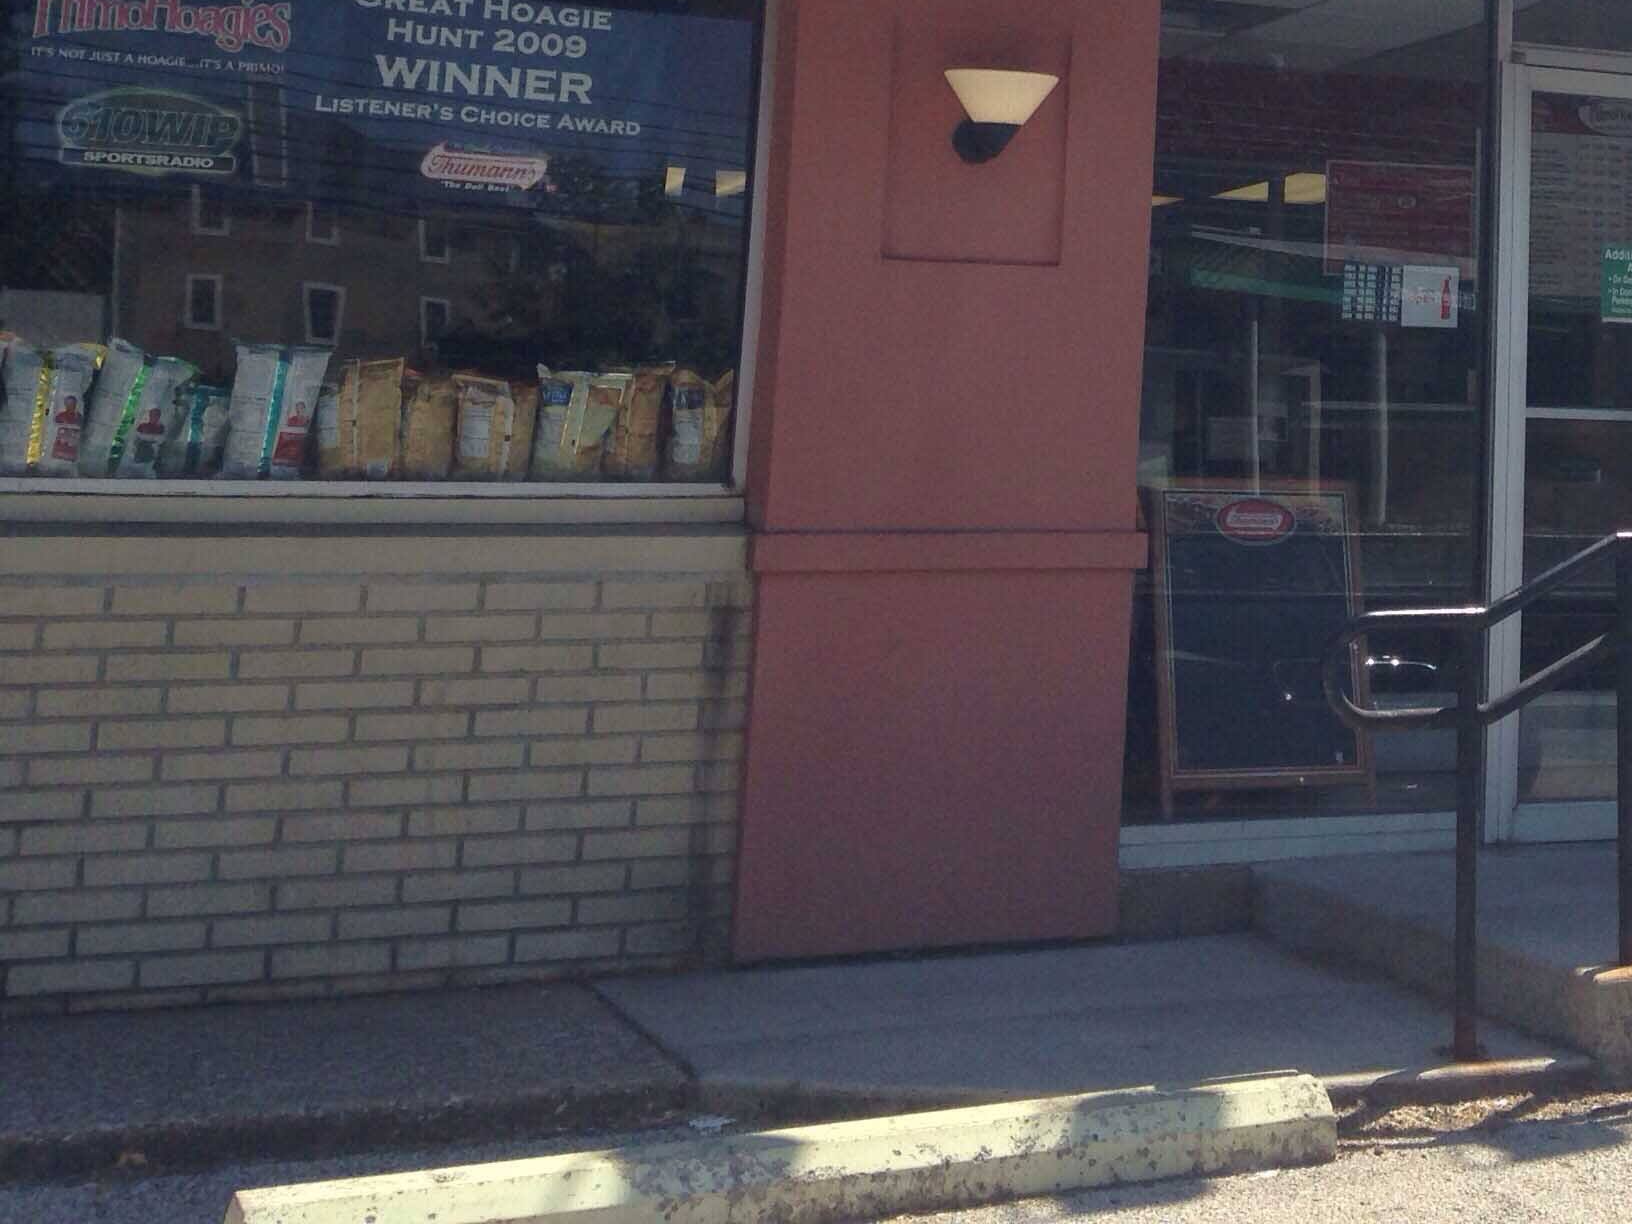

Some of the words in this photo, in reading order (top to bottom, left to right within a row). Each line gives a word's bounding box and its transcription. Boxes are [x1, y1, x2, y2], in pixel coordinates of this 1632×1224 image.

[493, 29, 587, 58] 2009
[375, 54, 593, 104] WINNER
[84, 151, 214, 169] SPORTSRADIO
